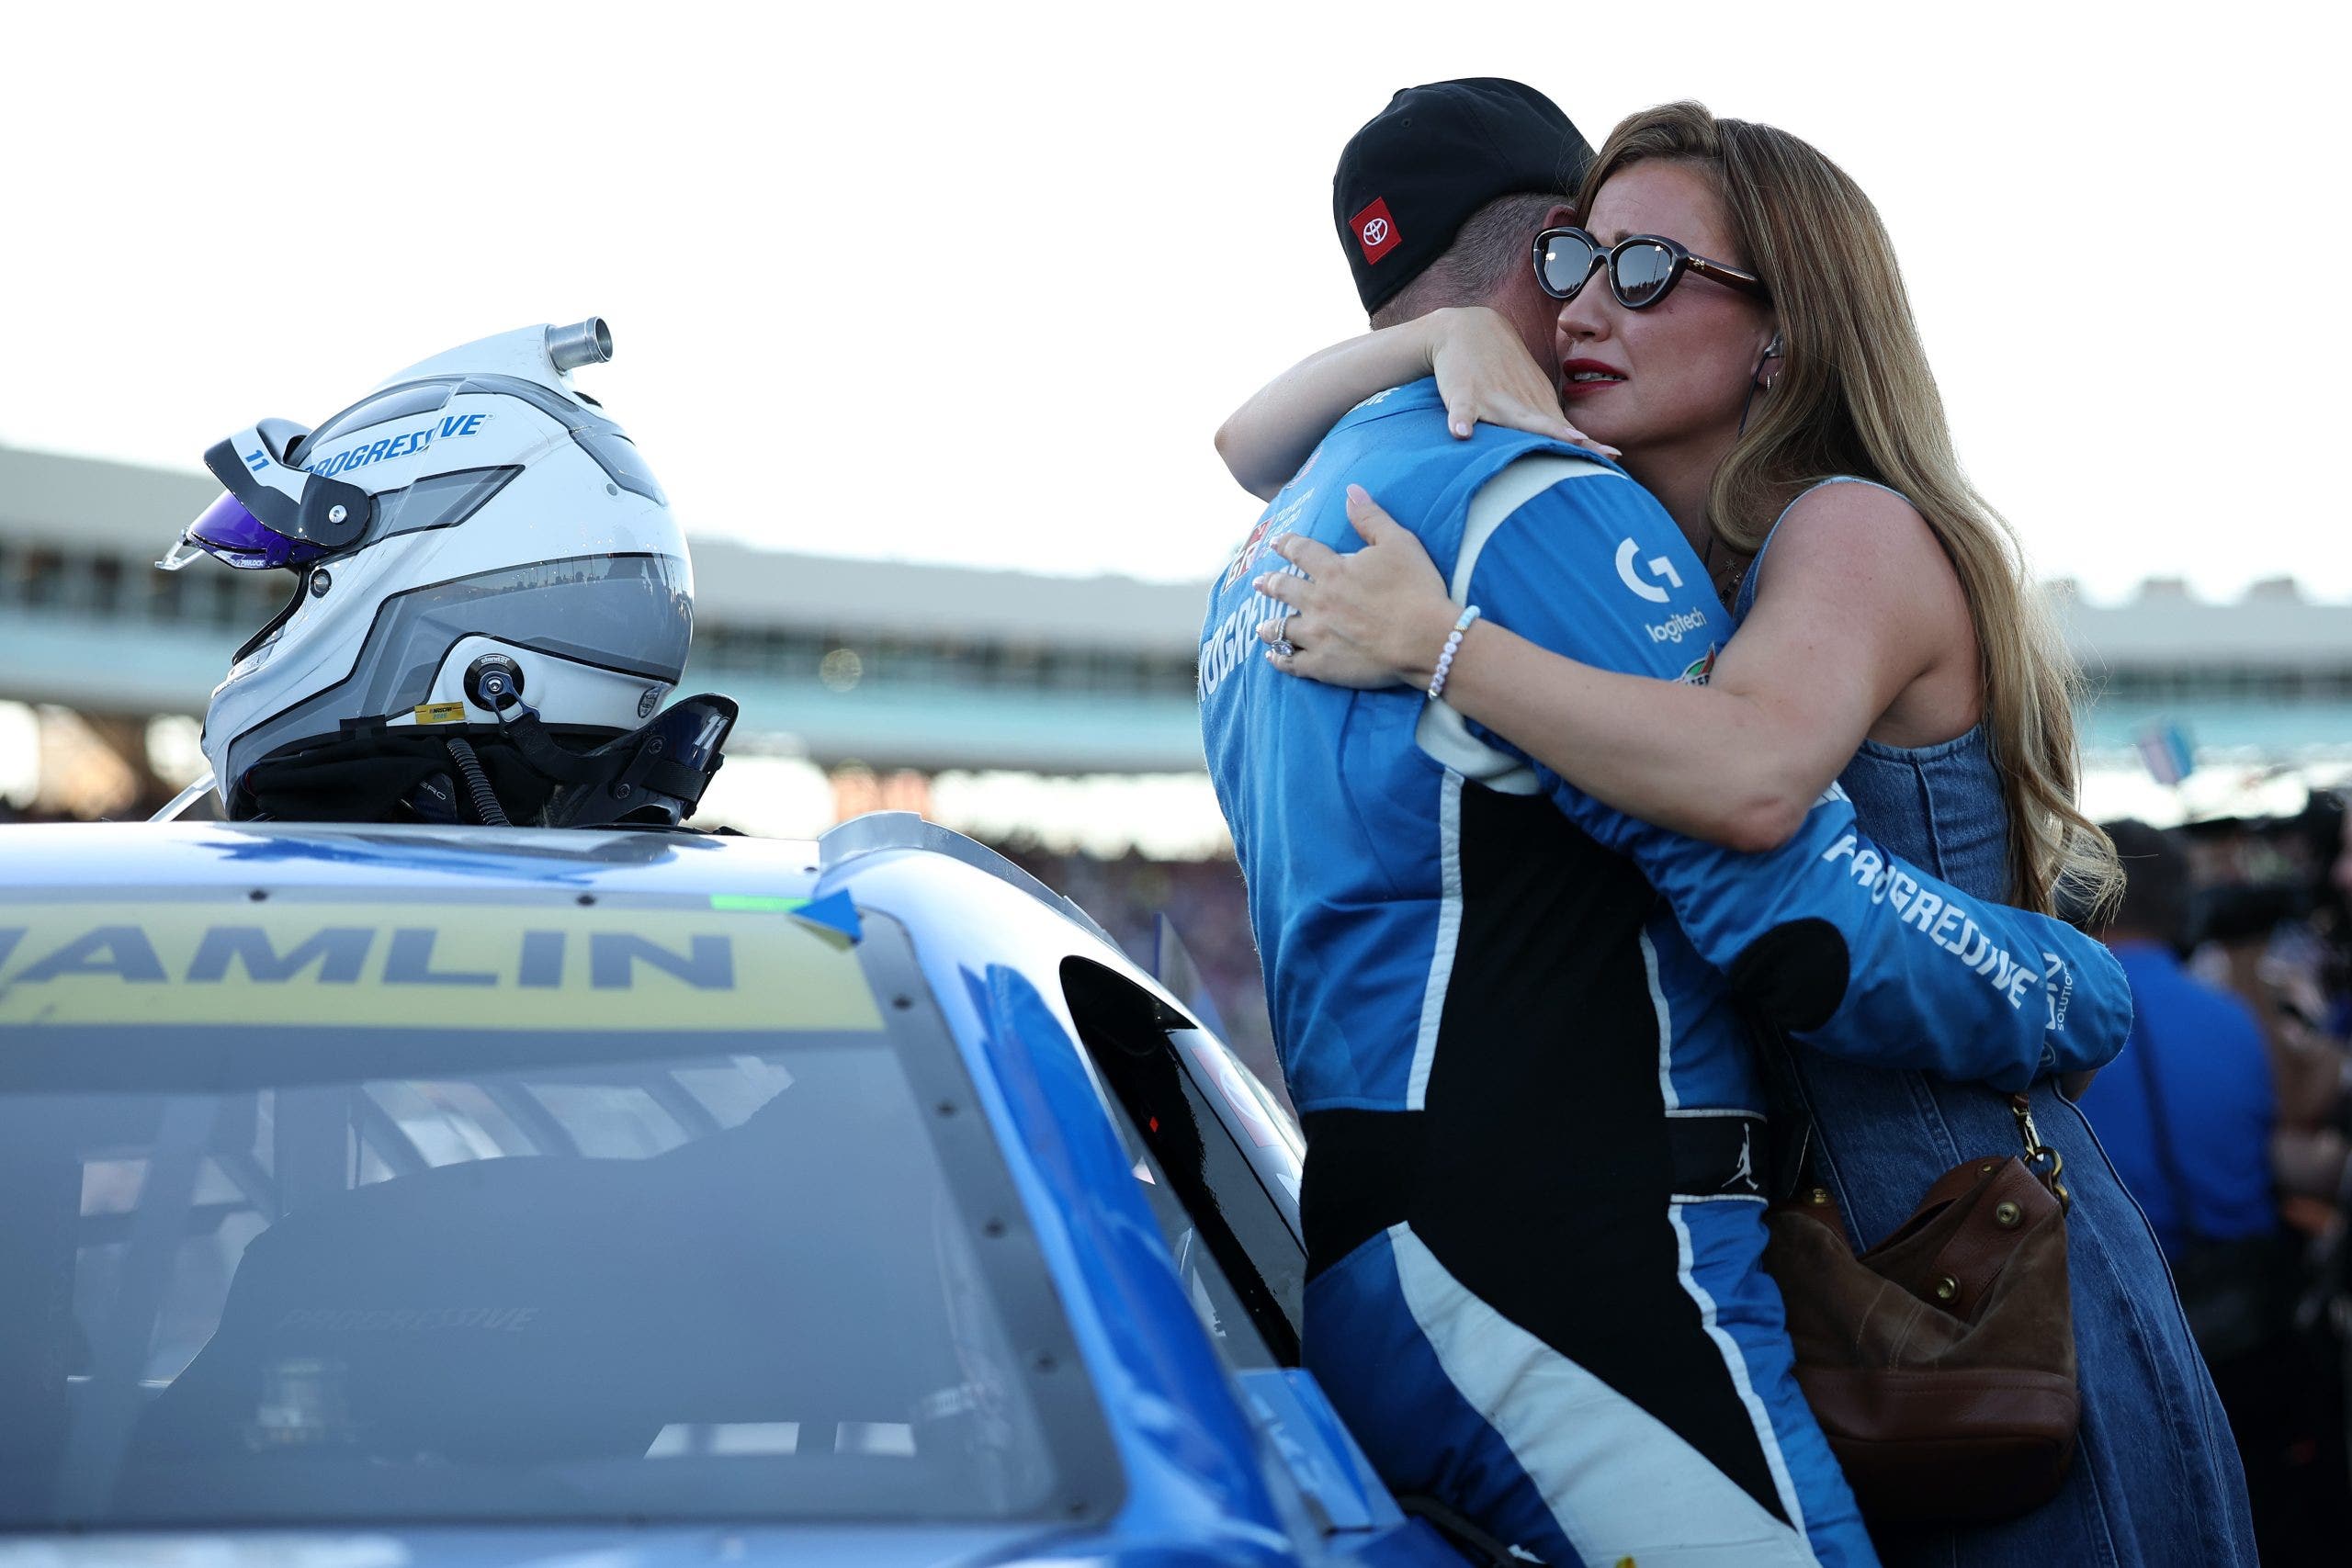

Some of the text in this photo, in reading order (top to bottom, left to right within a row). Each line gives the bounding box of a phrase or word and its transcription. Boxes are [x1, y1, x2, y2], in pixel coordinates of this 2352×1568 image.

[245, 449, 270, 472] 11
[1645, 606, 1707, 643] logitech
[694, 715, 730, 750] 11
[0, 925, 736, 992] AMLIN
